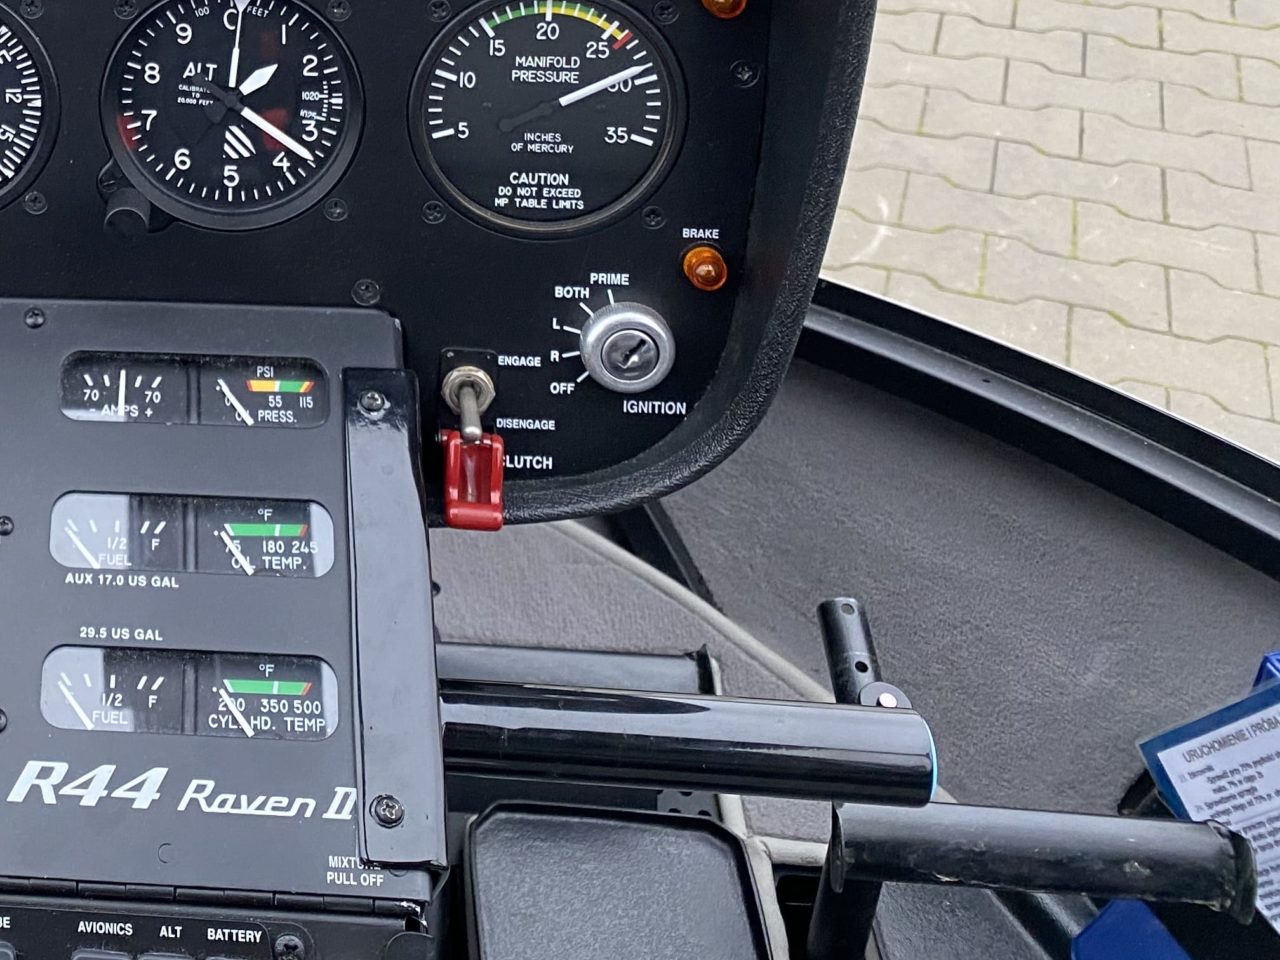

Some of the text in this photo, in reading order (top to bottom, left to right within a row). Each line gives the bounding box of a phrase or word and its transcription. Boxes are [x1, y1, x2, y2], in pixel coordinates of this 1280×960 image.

[195, 6, 269, 17] 100 FEET
[536, 23, 560, 40] 20
[586, 41, 610, 59] 25
[302, 55, 319, 77] 2
[515, 56, 580, 68] MANIFOLD
[459, 72, 476, 89] 10
[512, 70, 579, 83] PRESSURE
[302, 119, 318, 141] 3
[524, 133, 561, 142] INCHES
[511, 143, 574, 153] OF MERCURY
[223, 165, 239, 187] 5
[510, 173, 569, 185] CAUTION
[498, 187, 581, 197] DO NOT EXCEED
[495, 198, 584, 209] MP TABLE LIMITS
[682, 229, 719, 239] BRAKE
[590, 273, 629, 286] PRIME
[555, 286, 589, 298] BOTH
[553, 318, 560, 329] L
[498, 356, 541, 367] ENGAGE
[551, 351, 559, 362] R
[257, 366, 274, 377] PSI
[550, 383, 575, 395] OFF
[268, 395, 282, 408] 55
[623, 400, 686, 414] IGNITION
[257, 409, 297, 423] PRESS.
[496, 418, 556, 430] DISENGAGE
[502, 455, 553, 470] LUTCH
[258, 508, 273, 522] °F
[152, 538, 160, 551] F
[262, 541, 318, 554] 180 245
[98, 554, 132, 566] FUEL
[262, 556, 306, 570] TEMP.
[65, 573, 179, 588] AUX 17.0 US GAL
[80, 627, 163, 640] 29.5 US GAL
[259, 664, 274, 678] °F
[102, 693, 123, 706] 1/2
[149, 695, 158, 708] F
[260, 700, 321, 714] 350 500
[92, 710, 128, 724] FUEL
[7, 760, 358, 820] R44 Raven II
[326, 872, 384, 886] PULL OFF
[78, 921, 132, 935] AVIONICS
[159, 925, 182, 938] ALT
[207, 928, 262, 943] BATTERY
